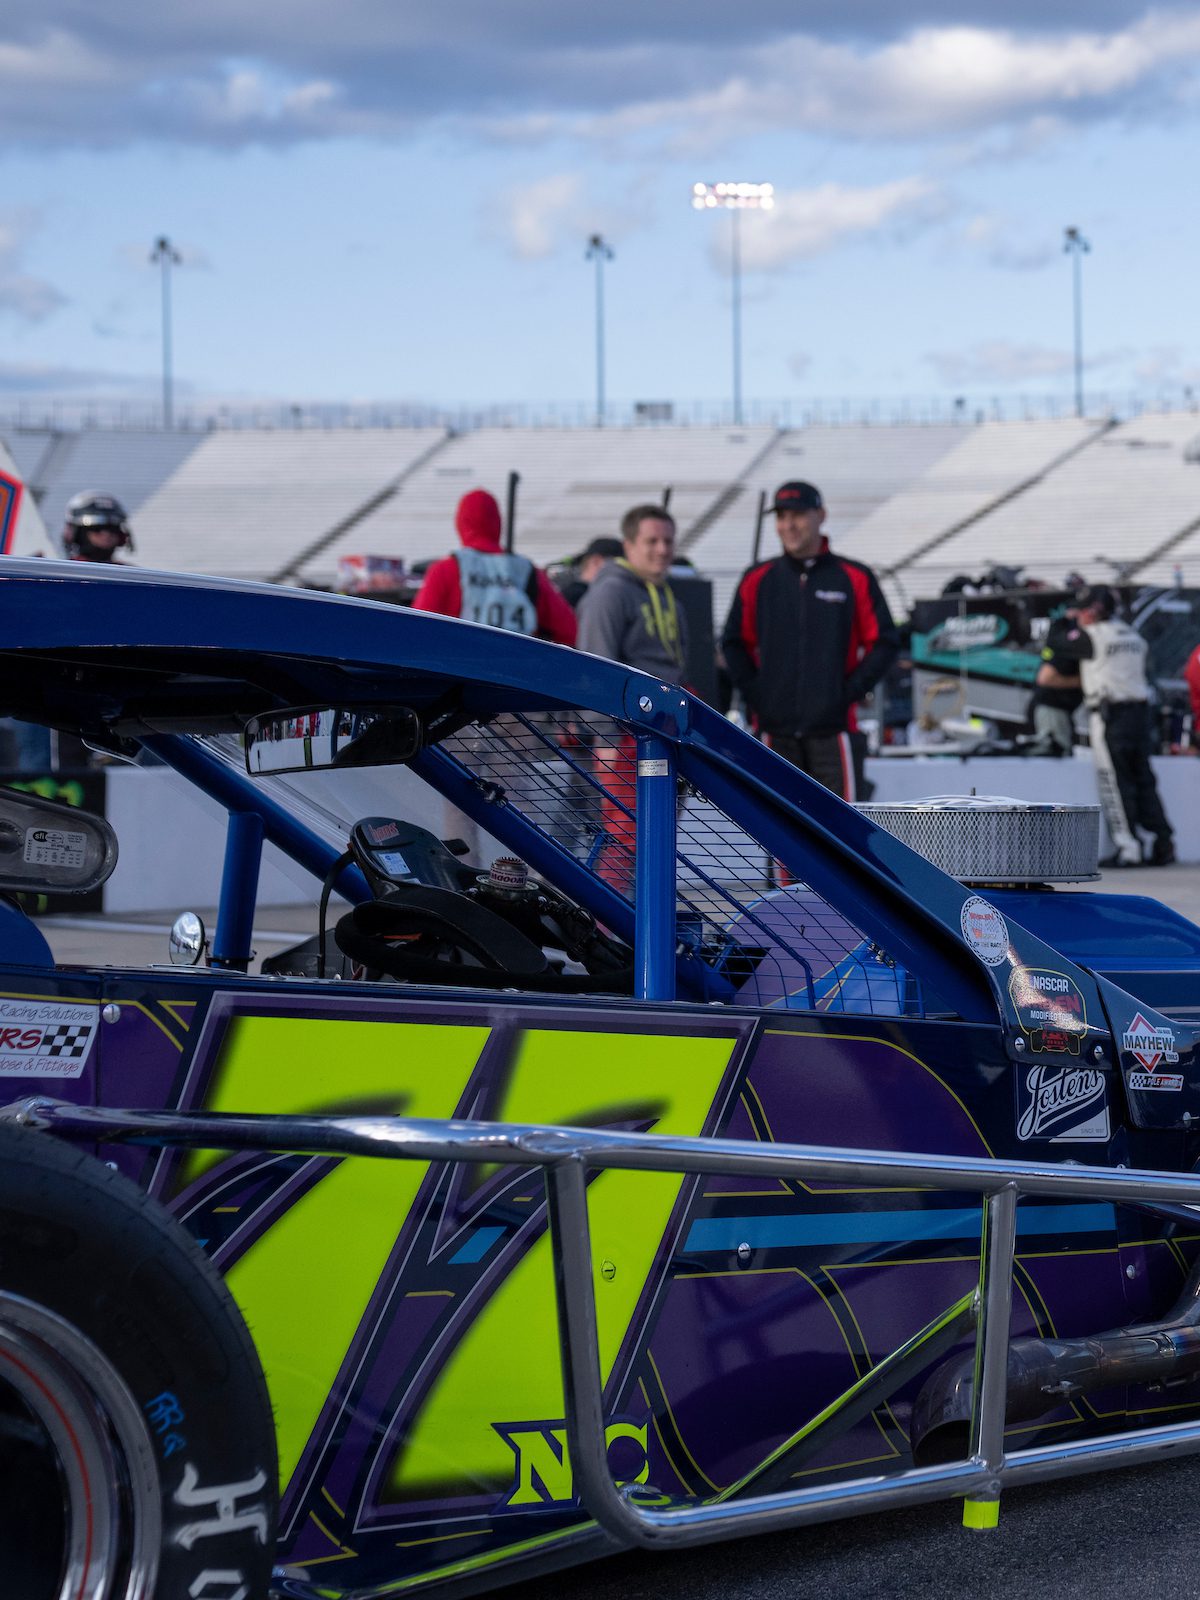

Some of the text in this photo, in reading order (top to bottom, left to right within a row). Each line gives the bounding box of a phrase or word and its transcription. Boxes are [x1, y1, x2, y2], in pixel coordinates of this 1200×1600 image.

[1033, 976, 1069, 993] NASCAR
[1, 1004, 94, 1021] Racing Solutions
[0, 1028, 42, 1050] RS
[1124, 1034, 1172, 1051] MAYHEW
[24, 1058, 34, 1072] &
[34, 1059, 80, 1076] Fittings
[1017, 1065, 1106, 1140] Jostens
[168, 1003, 746, 1517] 77
[507, 1422, 650, 1506] NC
